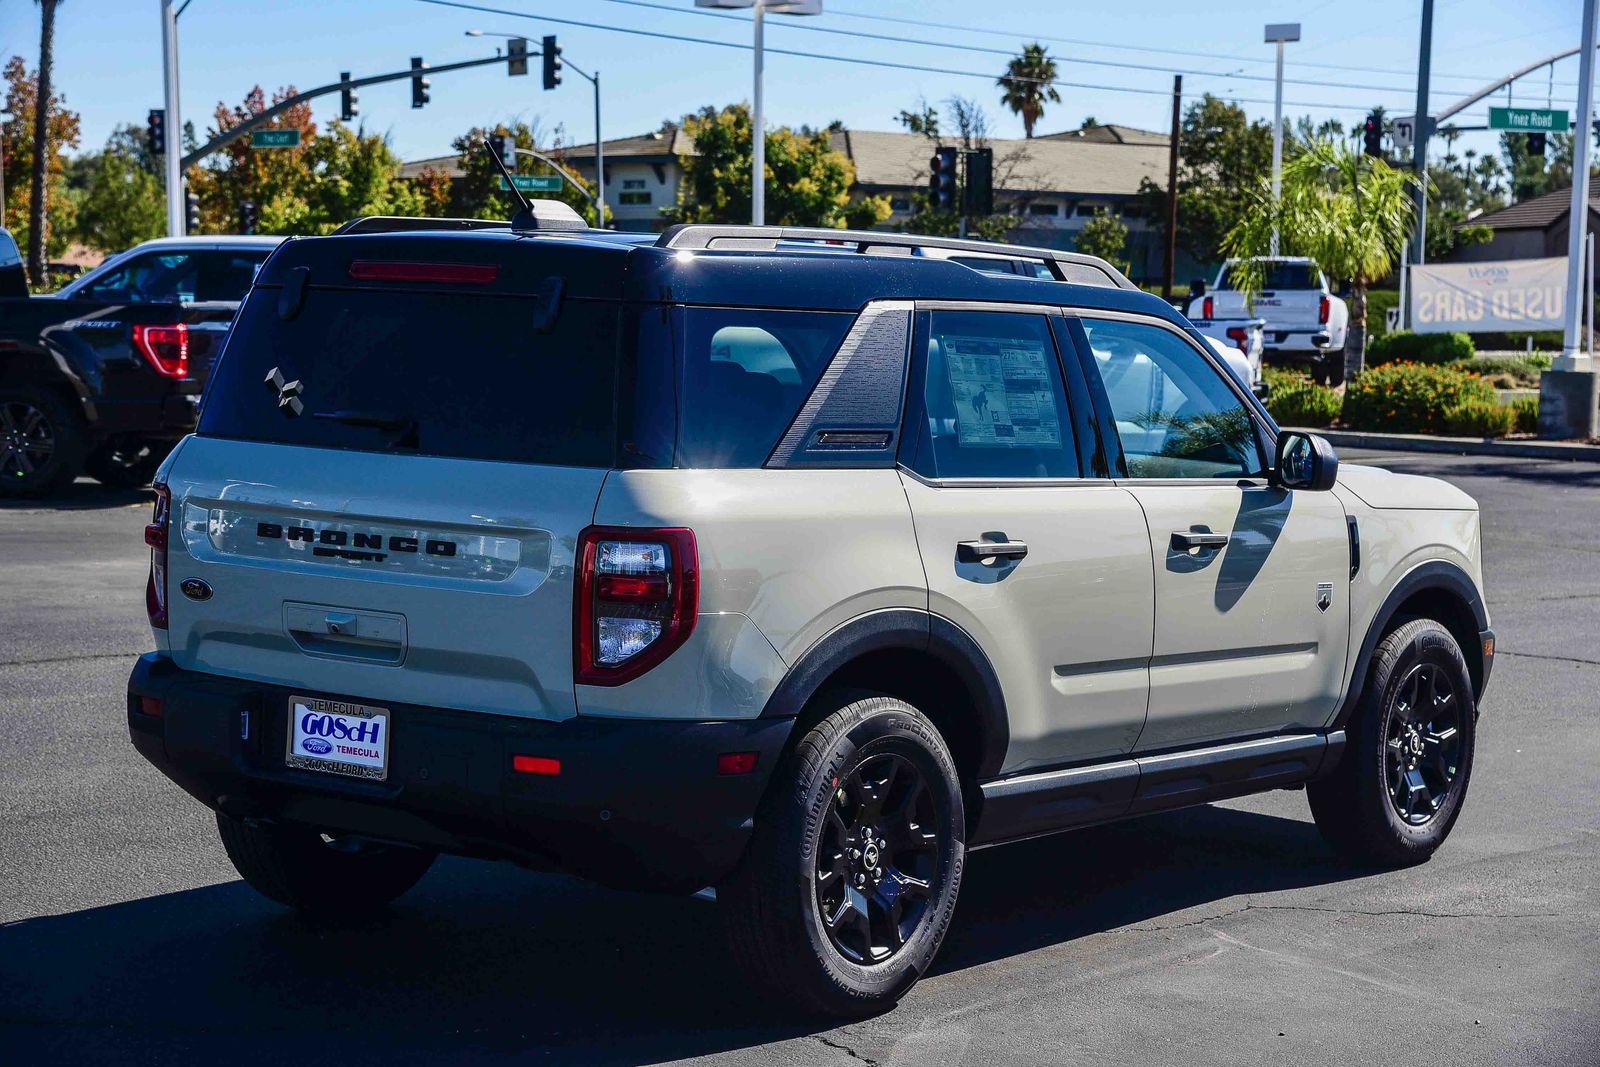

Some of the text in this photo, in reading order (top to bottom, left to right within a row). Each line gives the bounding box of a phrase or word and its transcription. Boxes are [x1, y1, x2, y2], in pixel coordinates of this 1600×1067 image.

[1507, 111, 1552, 127] Ynez Road
[257, 522, 458, 557] BRONCO
[313, 546, 388, 562] SPORT
[312, 700, 365, 716] TEMECULA
[307, 740, 380, 759] Ford TEMECULA
[342, 763, 364, 776] FORD
[800, 765, 840, 860] Continental
